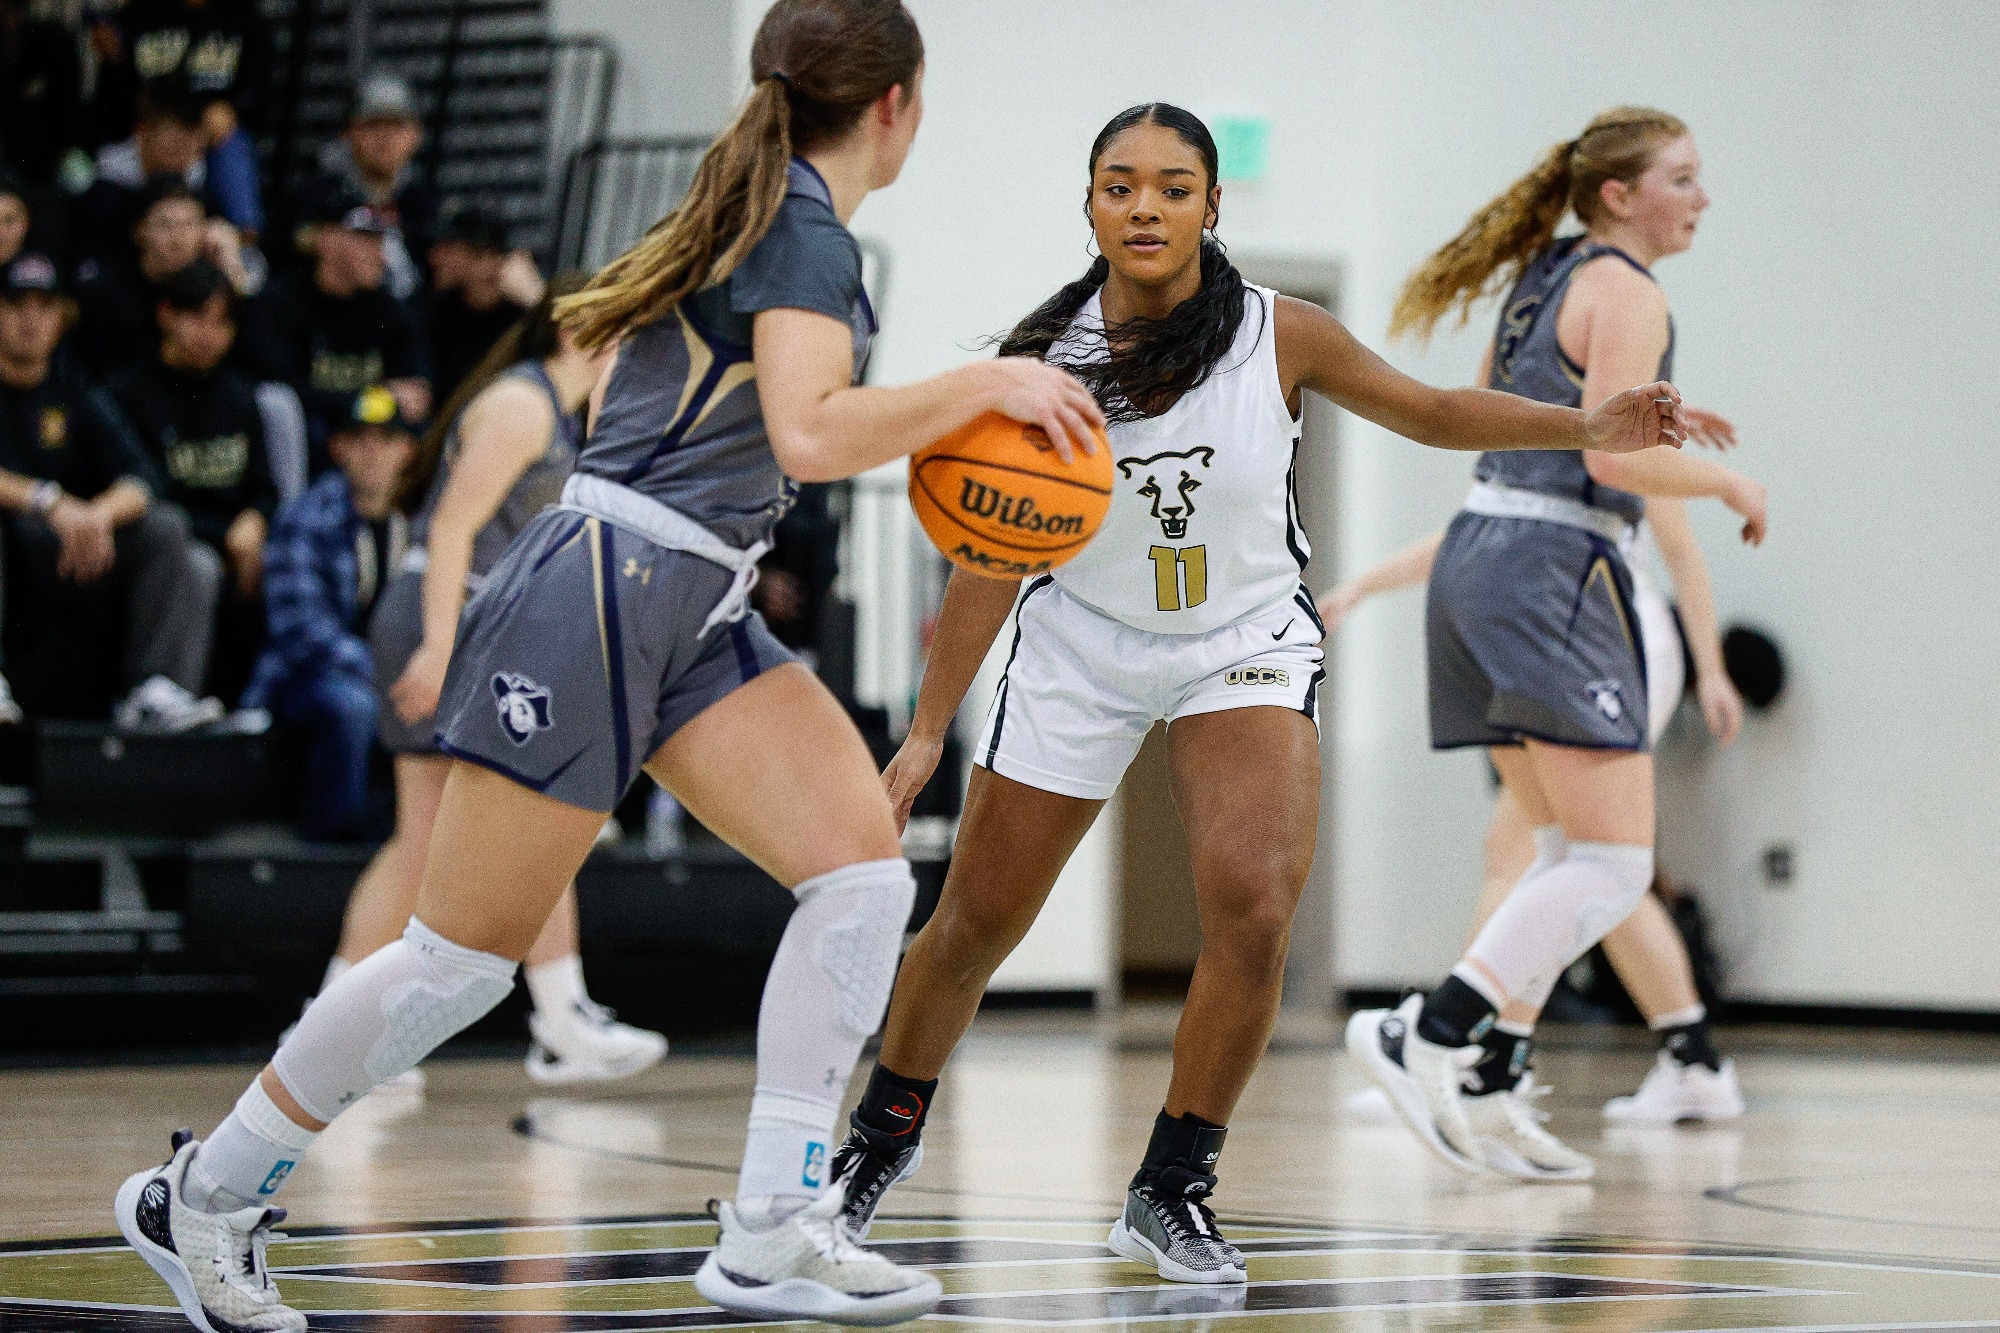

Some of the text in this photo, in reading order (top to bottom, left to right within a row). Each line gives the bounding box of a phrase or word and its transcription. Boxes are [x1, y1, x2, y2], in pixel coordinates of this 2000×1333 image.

[959, 477, 1084, 534] Wilson
[1149, 544, 1207, 611] 11
[1225, 667, 1289, 687] UCCS
